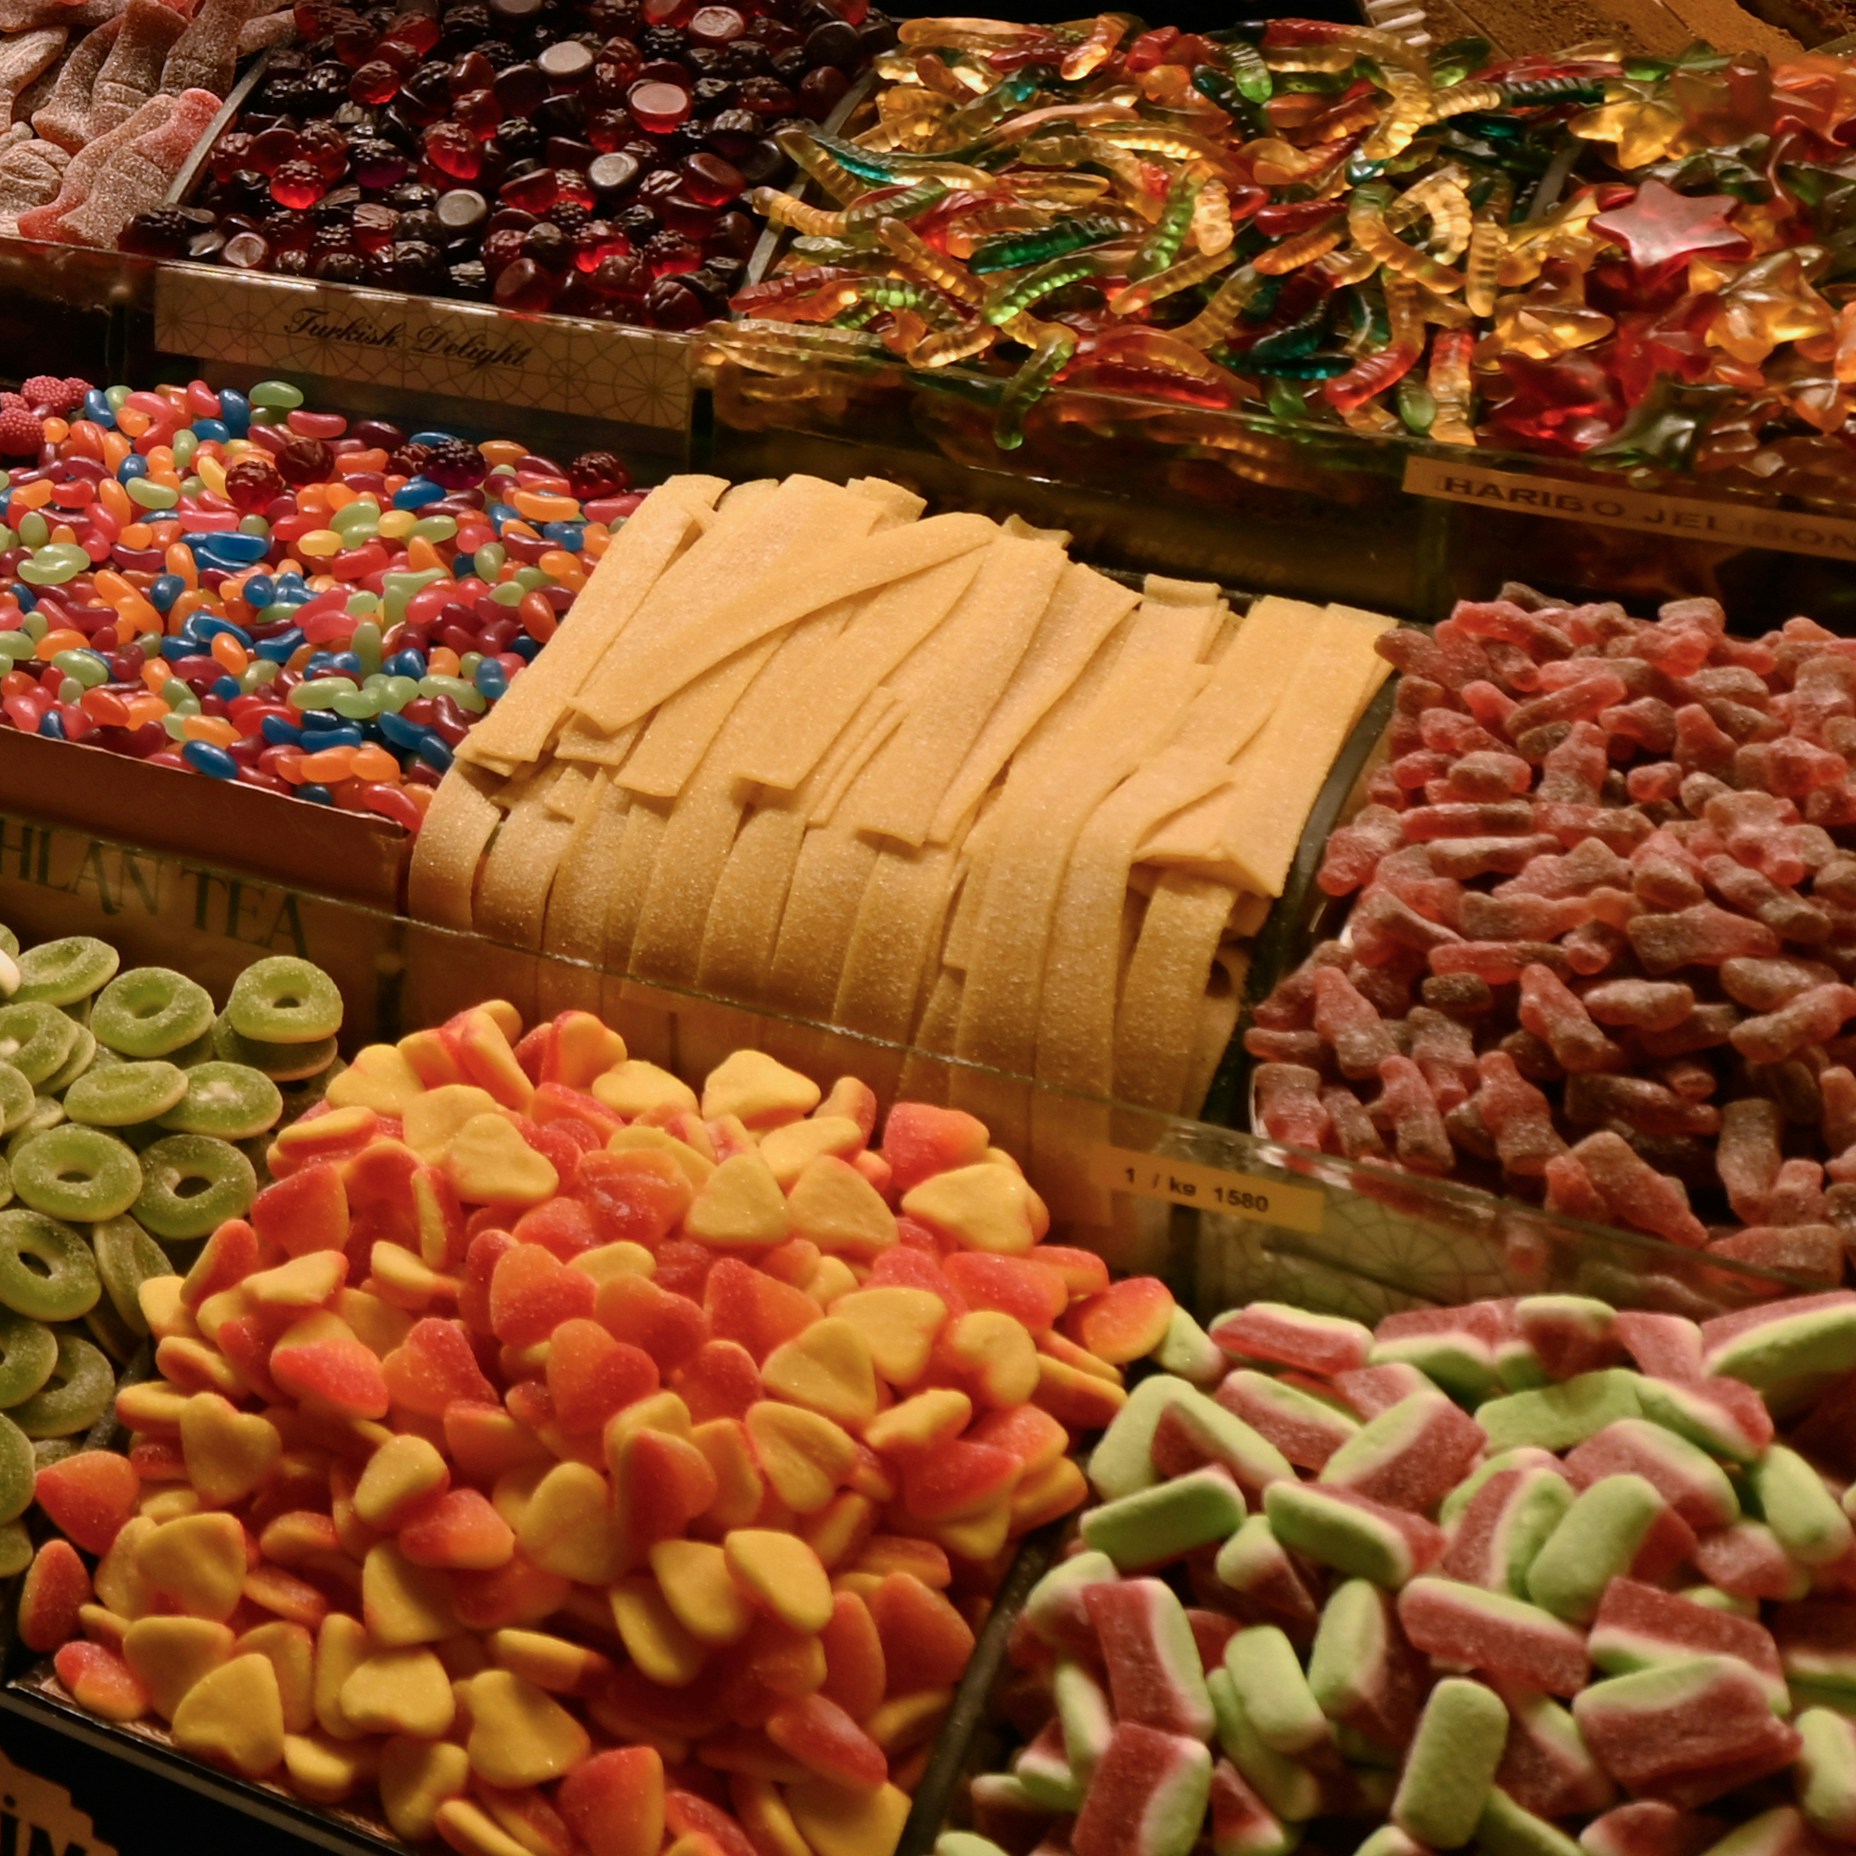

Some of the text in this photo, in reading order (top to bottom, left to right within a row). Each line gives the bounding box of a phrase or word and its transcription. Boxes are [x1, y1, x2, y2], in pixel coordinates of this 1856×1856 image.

[1441, 475, 1625, 519] HARIBO
[1123, 1166, 1271, 1214] 1 kg 1580
